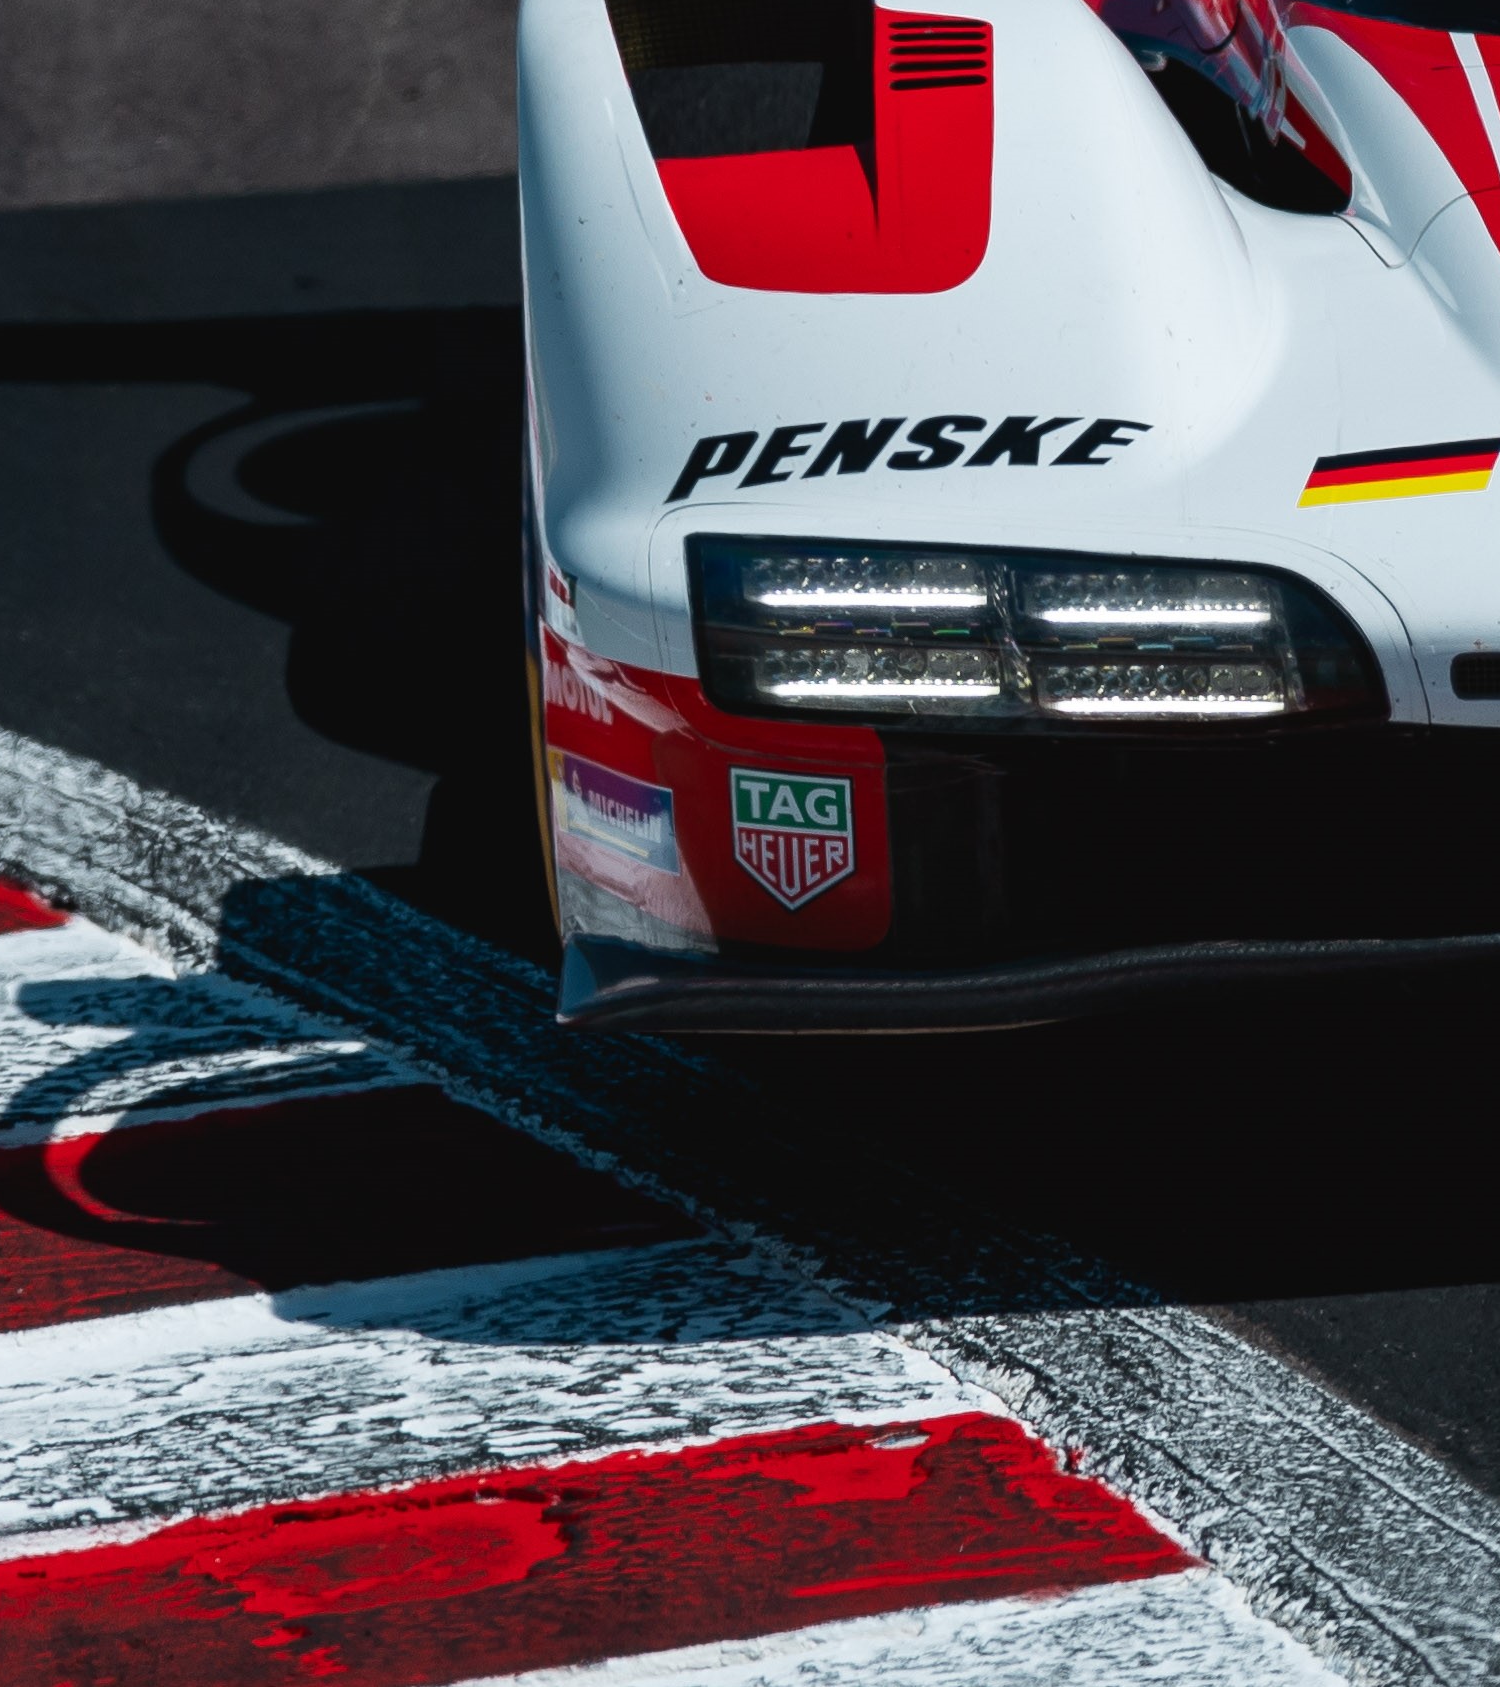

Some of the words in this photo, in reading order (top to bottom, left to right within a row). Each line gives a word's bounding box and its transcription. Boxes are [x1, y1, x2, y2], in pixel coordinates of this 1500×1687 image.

[664, 415, 1153, 504] PENSKE
[587, 789, 662, 844] MICHELIN
[739, 781, 838, 826] TAG
[740, 832, 846, 898] HEUER
